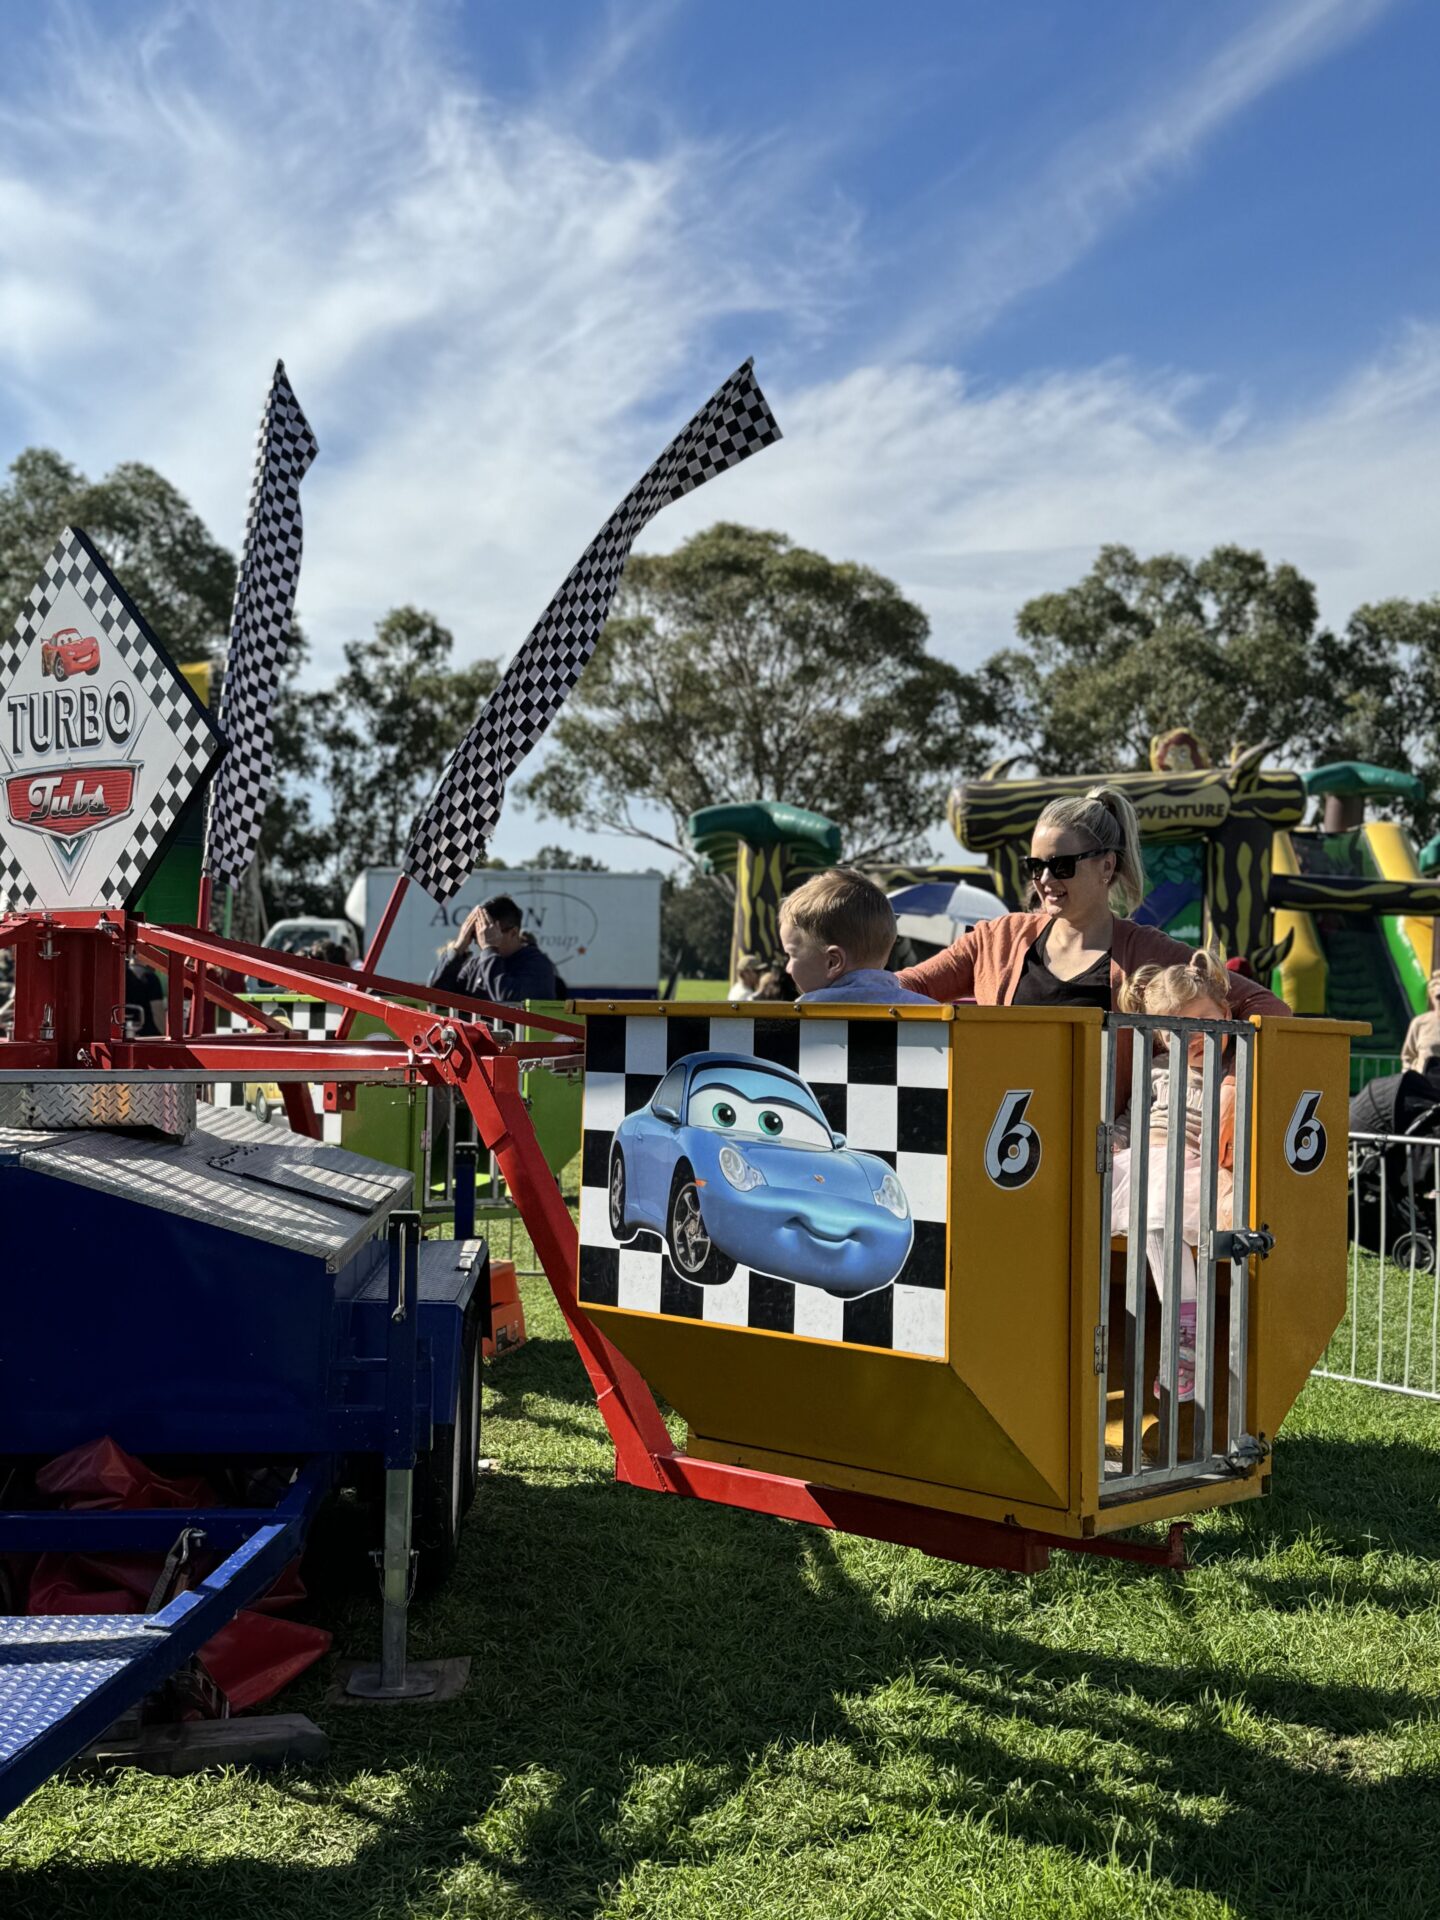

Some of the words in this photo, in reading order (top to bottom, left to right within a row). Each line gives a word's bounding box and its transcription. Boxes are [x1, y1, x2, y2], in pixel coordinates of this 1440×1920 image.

[8, 681, 135, 755] TURBO
[28, 776, 111, 819] Tubs
[1136, 803, 1225, 819] DVENTURE
[539, 933, 579, 951] roup
[984, 1089, 1042, 1190] 6
[1284, 1090, 1328, 1175] 6
